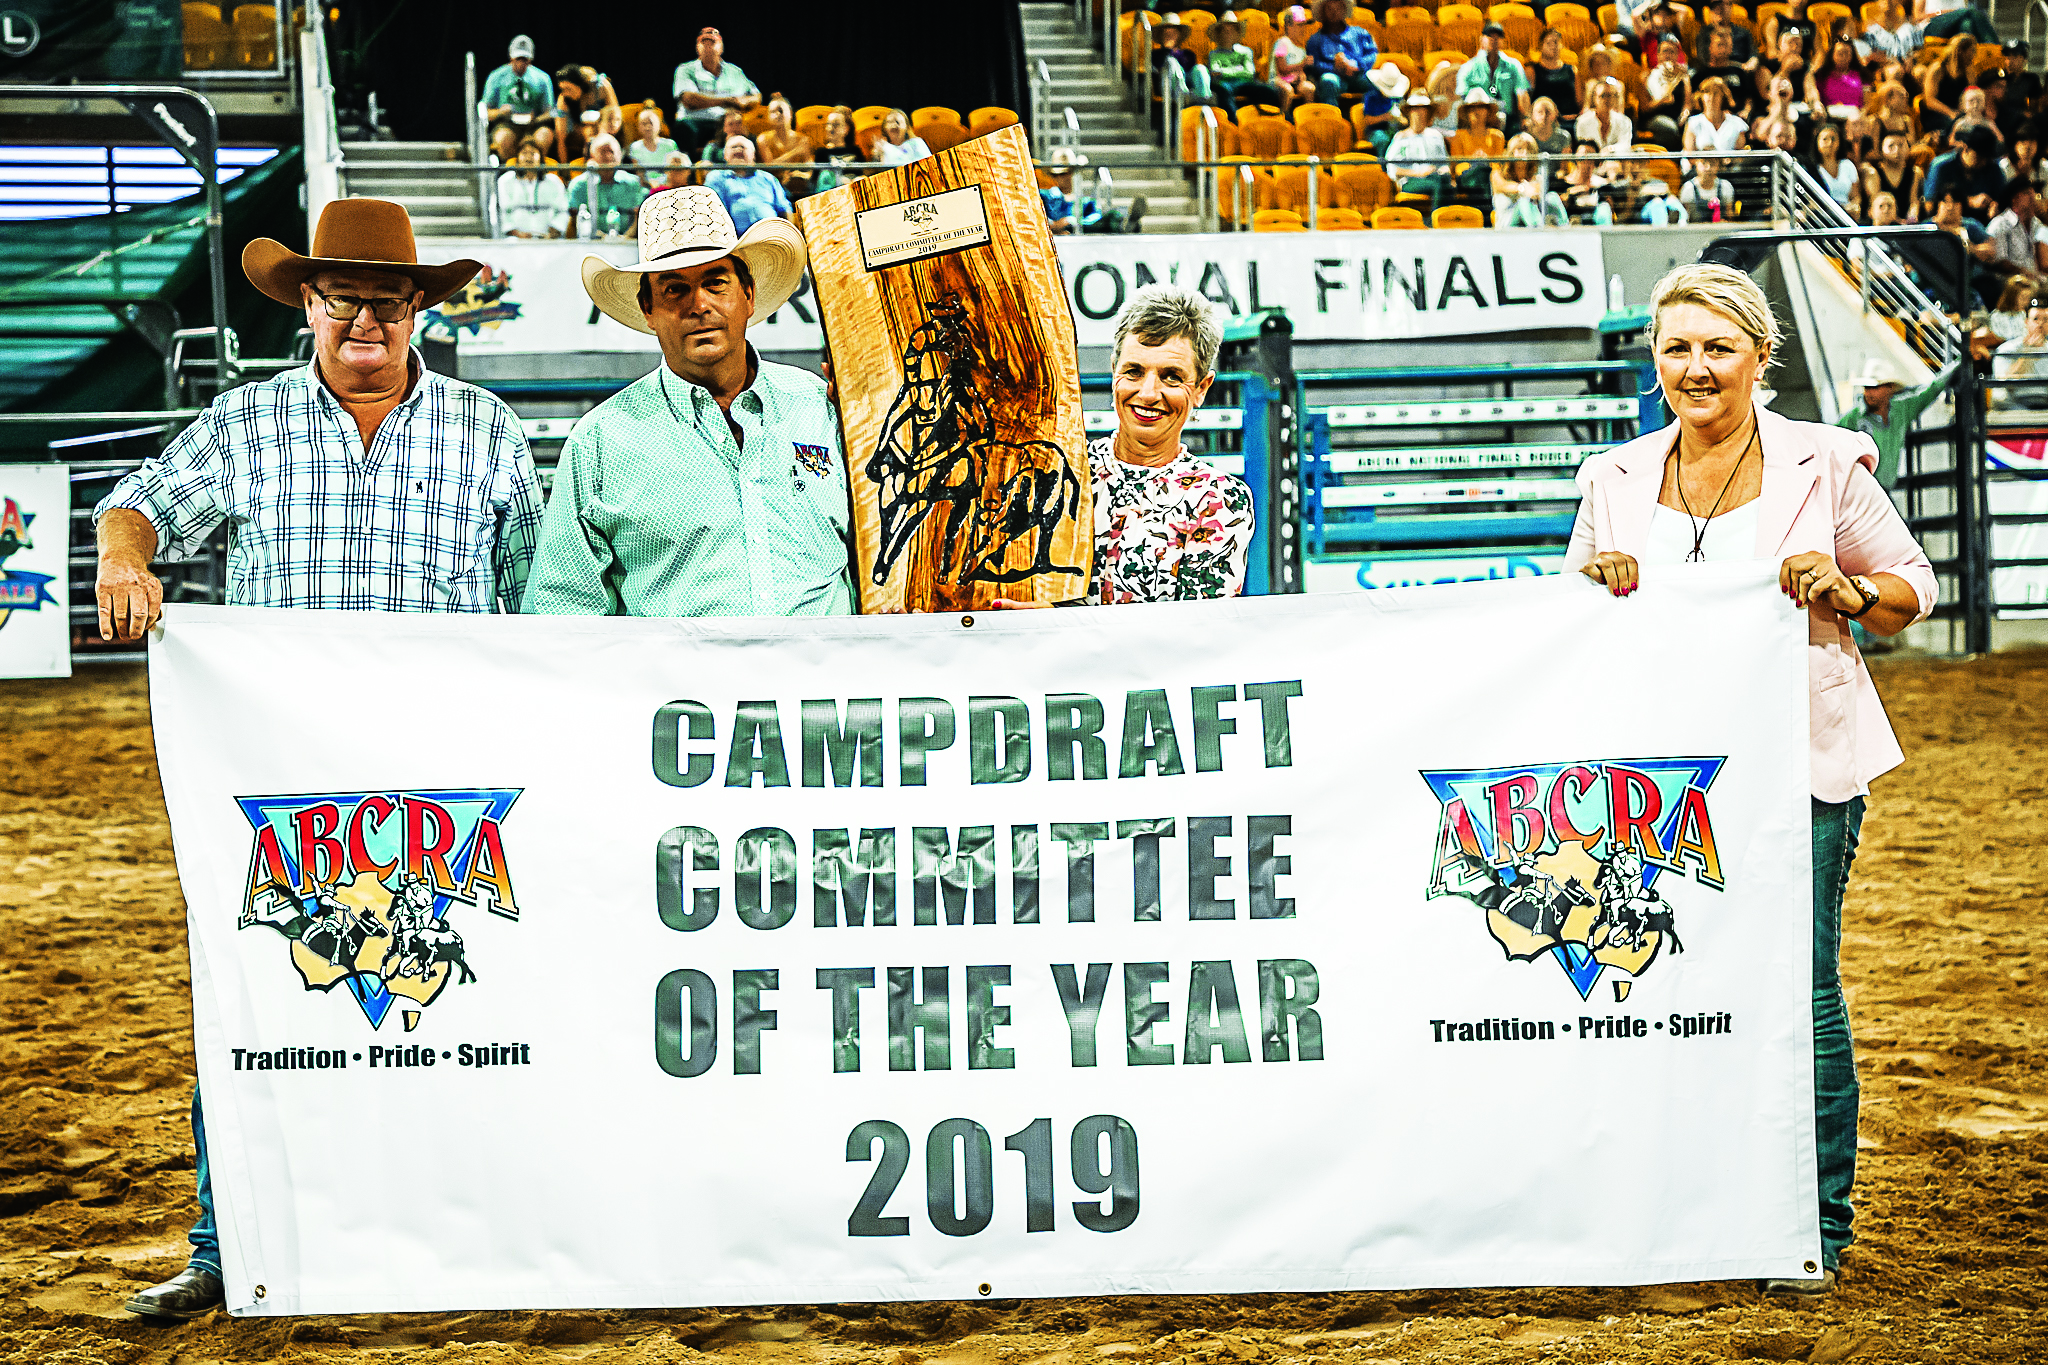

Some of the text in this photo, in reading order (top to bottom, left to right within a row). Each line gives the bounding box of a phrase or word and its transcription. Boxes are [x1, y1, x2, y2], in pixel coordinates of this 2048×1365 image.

[3, 16, 27, 44] L
[903, 203, 939, 222] ABCRA
[918, 244, 937, 254] 2019
[1314, 252, 1584, 313] FINALS
[0, 585, 36, 603] ALS
[651, 680, 1303, 788] CAMPDRAFT
[238, 793, 520, 930] ABCRA
[1426, 764, 1725, 901] ABCRA
[656, 815, 1297, 932] COMMITTEE
[655, 958, 1324, 1078] OF THE YEAR
[1429, 1012, 1732, 1042] Tradition Pride Spirit
[231, 1042, 531, 1071] Tradition Pride Spirit
[845, 1114, 1140, 1237] 2019
